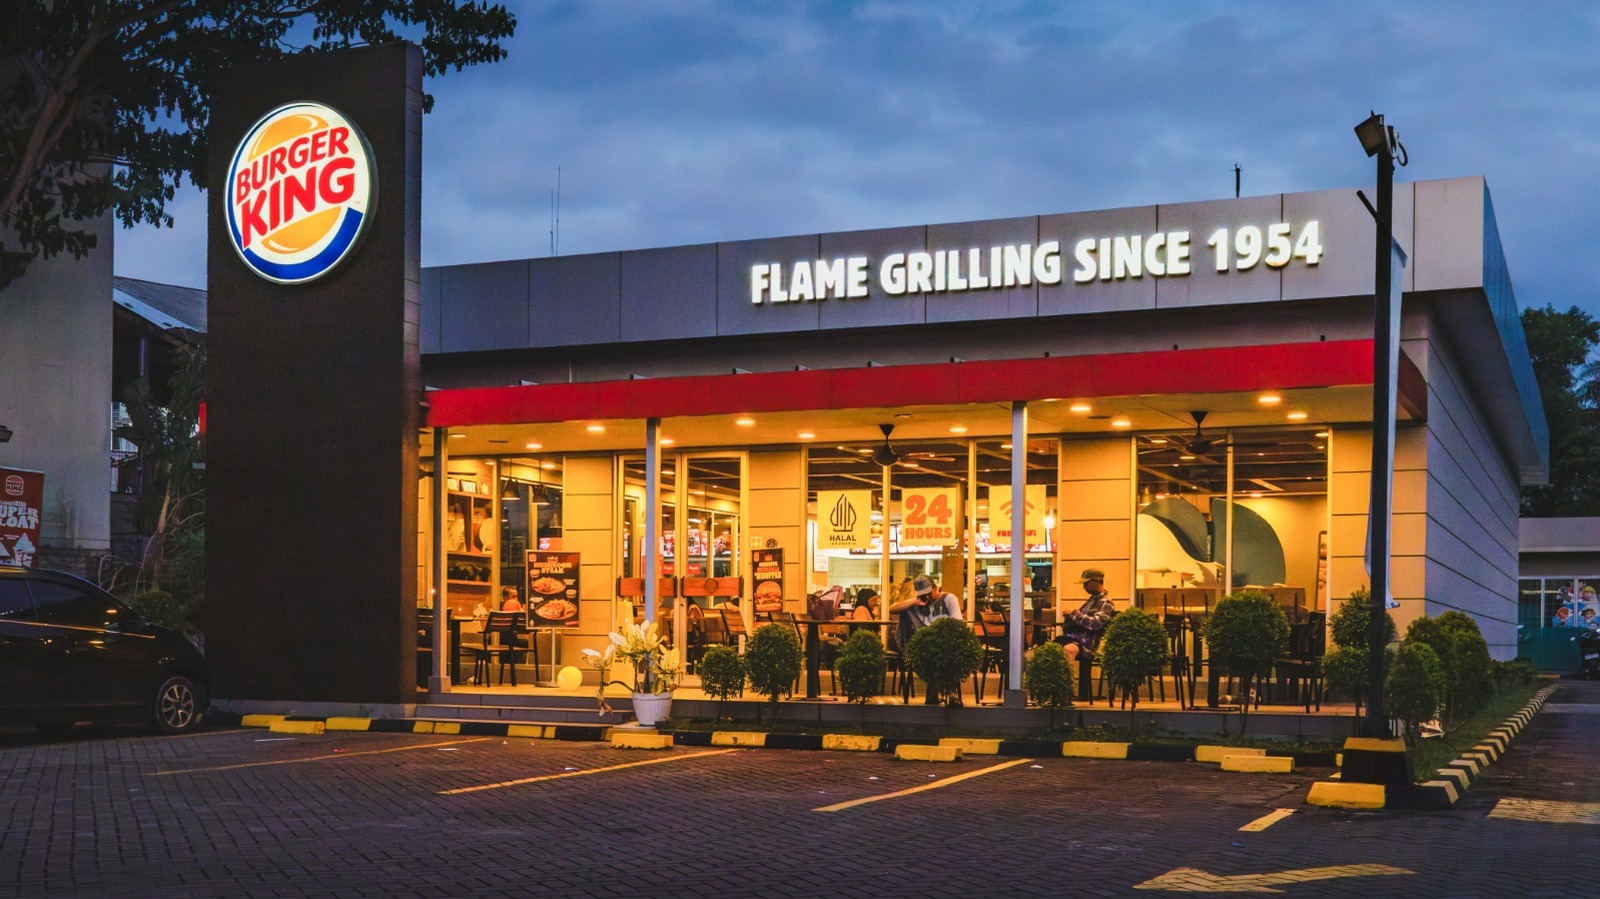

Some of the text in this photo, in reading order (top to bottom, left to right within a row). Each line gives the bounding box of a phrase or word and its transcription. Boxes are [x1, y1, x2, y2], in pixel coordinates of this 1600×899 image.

[236, 126, 349, 207] BURGER
[241, 156, 355, 250] KING
[751, 220, 1323, 304] FLAME GRILLING SINCE 1954
[0, 505, 38, 518] UPER
[904, 493, 953, 525] 24
[0, 515, 39, 529] LOAT
[905, 526, 952, 540] HOURS
[829, 534, 857, 542] HALAL
